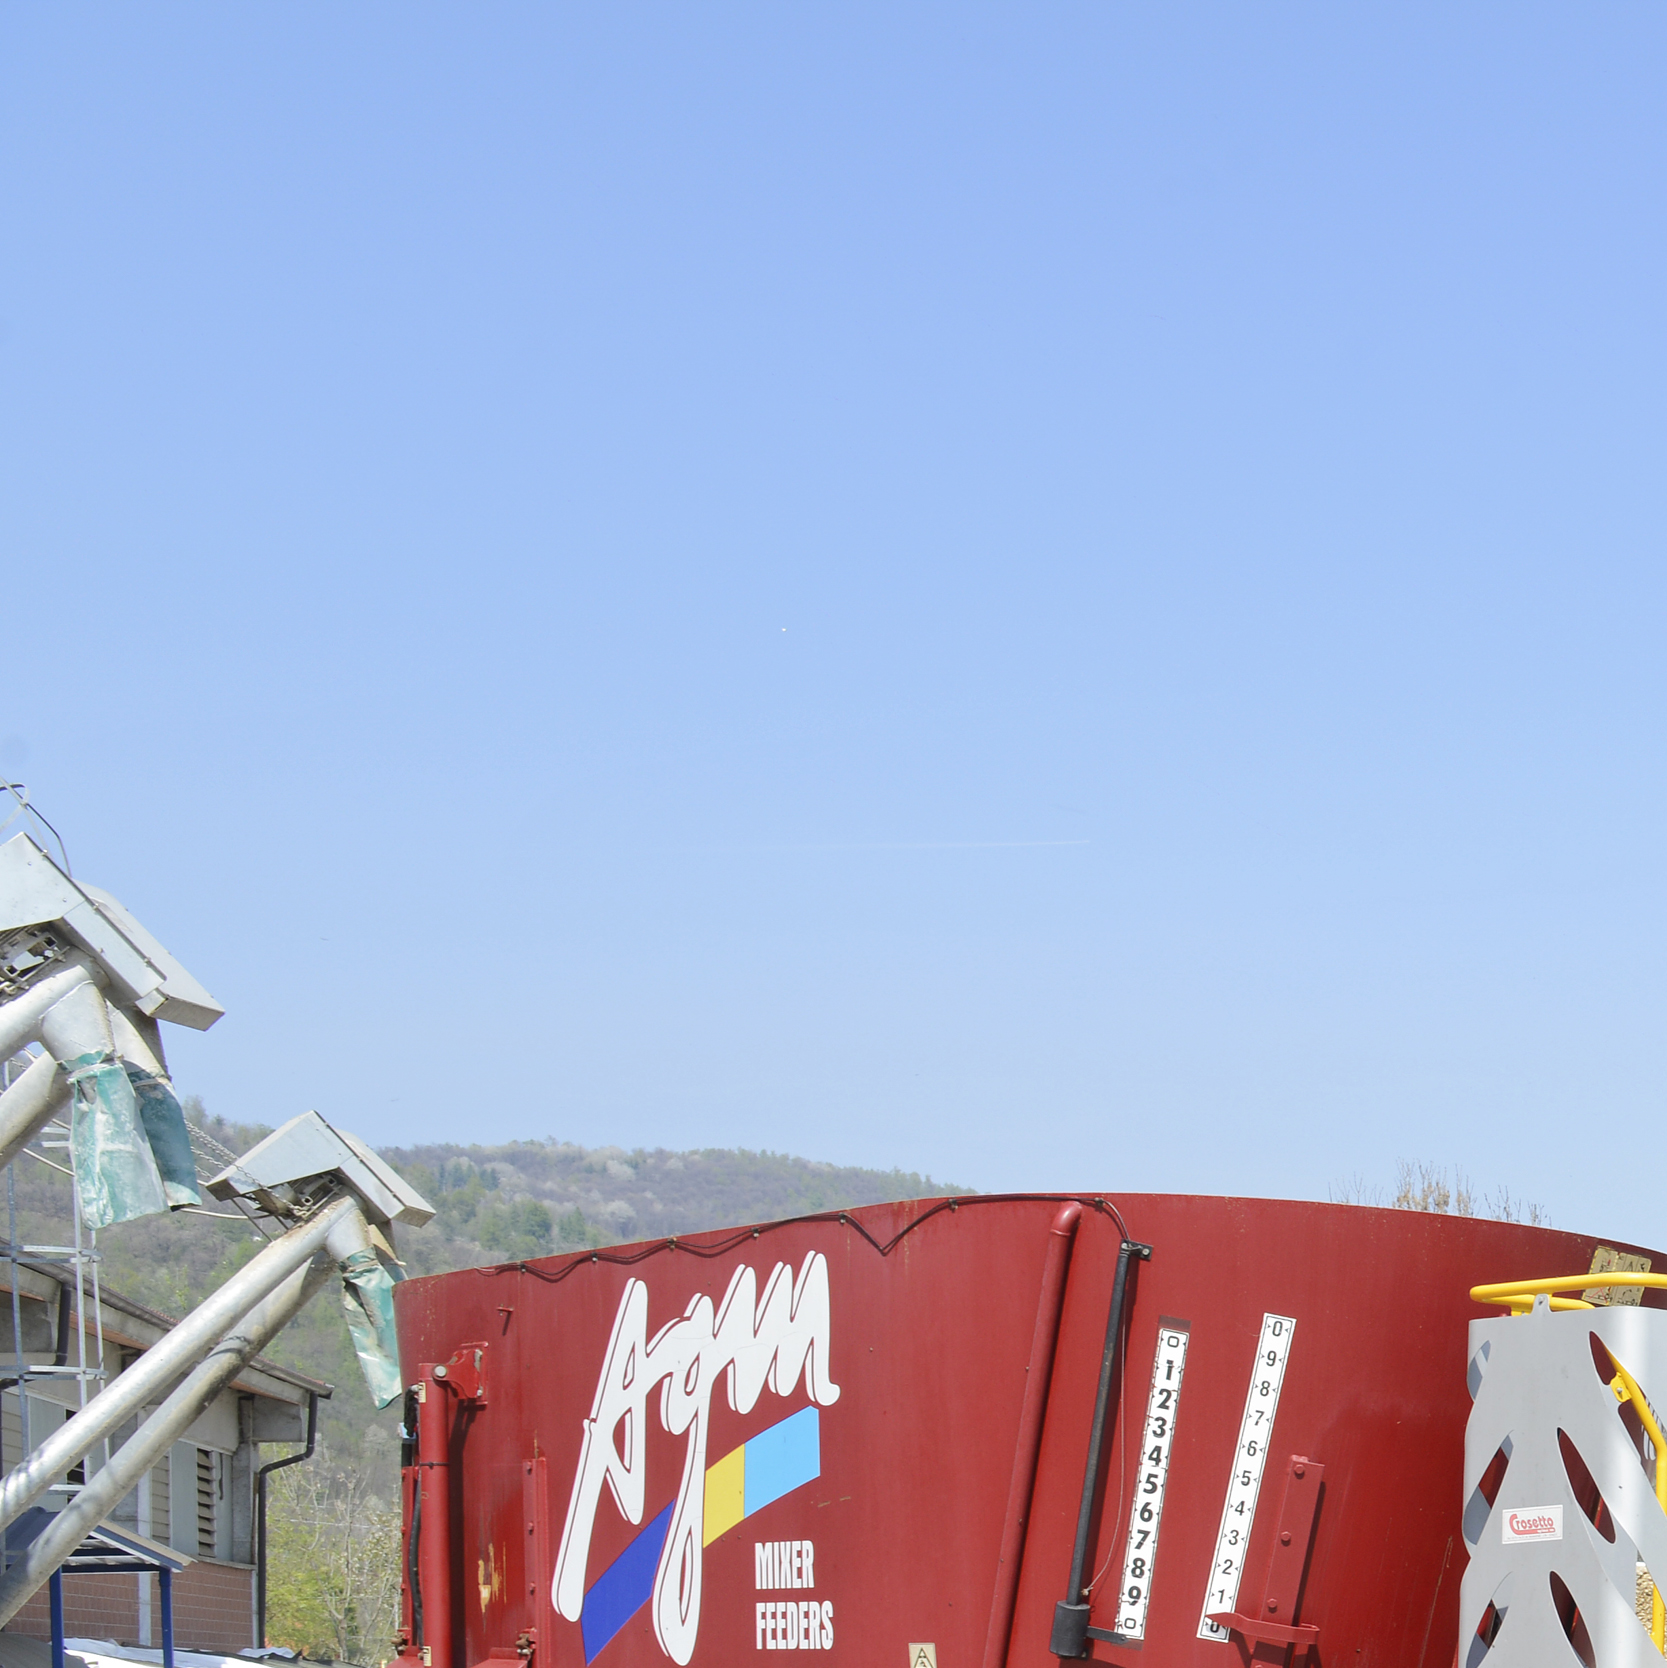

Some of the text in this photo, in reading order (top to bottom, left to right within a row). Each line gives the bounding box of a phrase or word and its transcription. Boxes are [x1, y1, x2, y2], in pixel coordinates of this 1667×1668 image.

[1271, 1320, 1283, 1337] 0
[1265, 1350, 1277, 1367] 9
[1156, 1388, 1172, 1410] 2
[1259, 1380, 1271, 1397] 8
[1152, 1416, 1167, 1438] 3
[1254, 1410, 1265, 1426] 7
[1147, 1445, 1162, 1467] 4
[1247, 1440, 1258, 1457] 6
[1142, 1472, 1159, 1494] 5
[1240, 1470, 1252, 1486] 5
[1139, 1502, 1154, 1523] 6
[1234, 1500, 1246, 1516] 4
[1508, 1513, 1556, 1536] Crosetto
[1134, 1529, 1152, 1550] 7
[1228, 1529, 1240, 1546] 3
[755, 1540, 815, 1589] MIXER
[1130, 1557, 1146, 1579] 8
[1221, 1559, 1233, 1575] 2
[1127, 1585, 1142, 1607] 9
[1217, 1589, 1226, 1604] 1
[755, 1601, 834, 1650] FEEDERS
